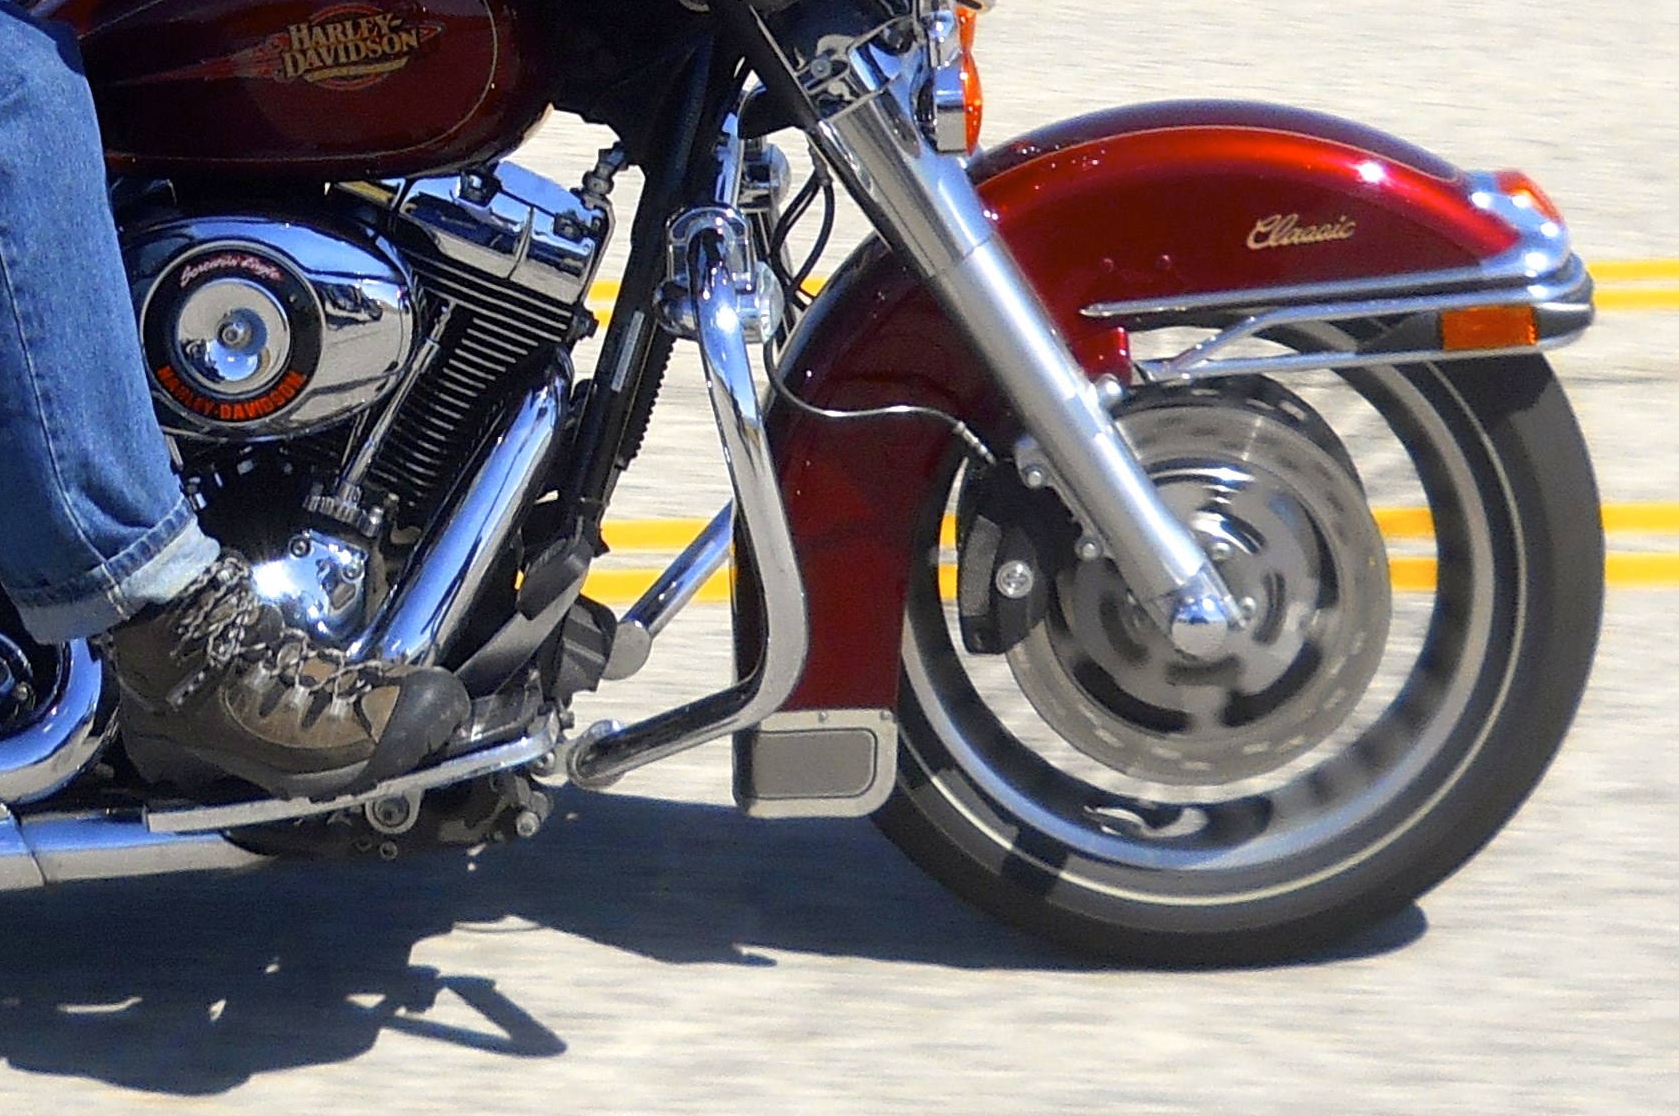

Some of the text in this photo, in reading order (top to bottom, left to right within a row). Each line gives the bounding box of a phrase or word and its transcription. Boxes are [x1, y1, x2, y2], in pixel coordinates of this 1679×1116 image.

[288, 13, 403, 51] HARLEY-
[283, 29, 419, 79] DAVIDSON
[1246, 213, 1356, 250] Classic
